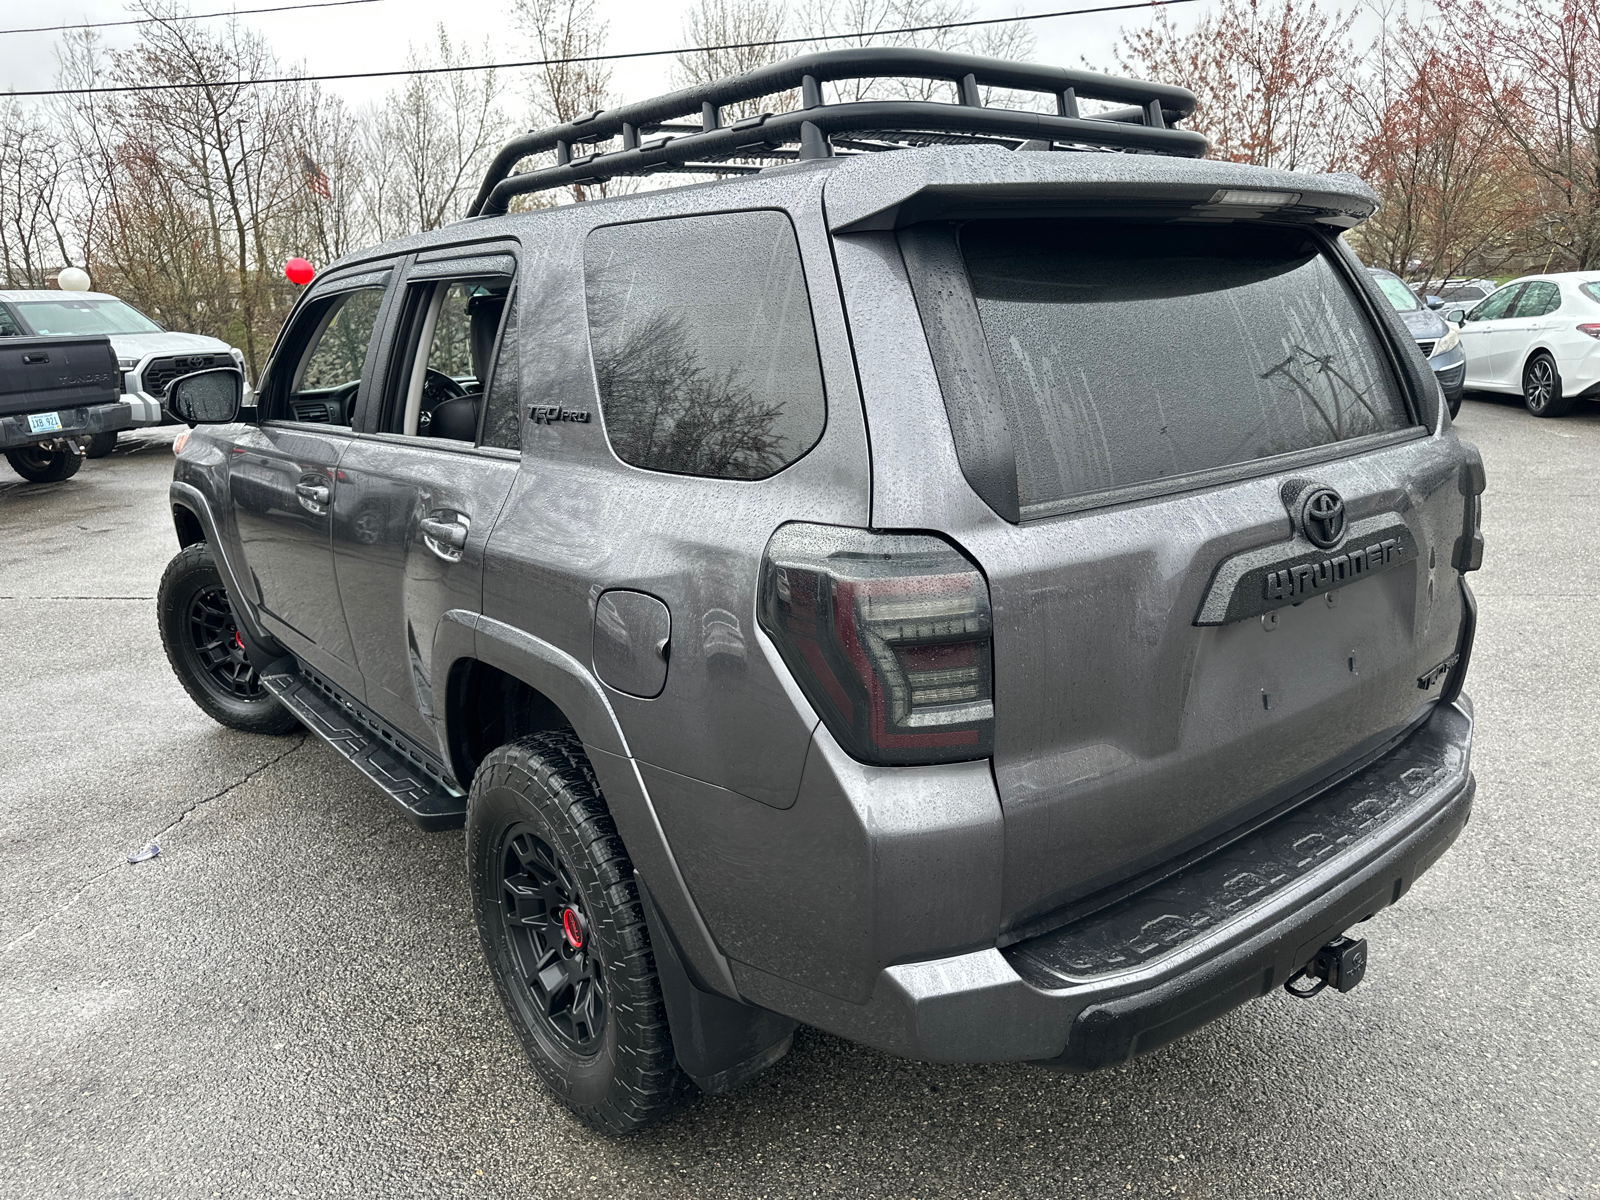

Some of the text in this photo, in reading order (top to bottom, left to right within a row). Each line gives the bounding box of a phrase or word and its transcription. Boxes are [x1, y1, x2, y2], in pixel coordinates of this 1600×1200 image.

[58, 372, 110, 385] TUNDRA
[527, 403, 591, 425] TRD PRO
[1346, 959, 1366, 979] TOYOT
